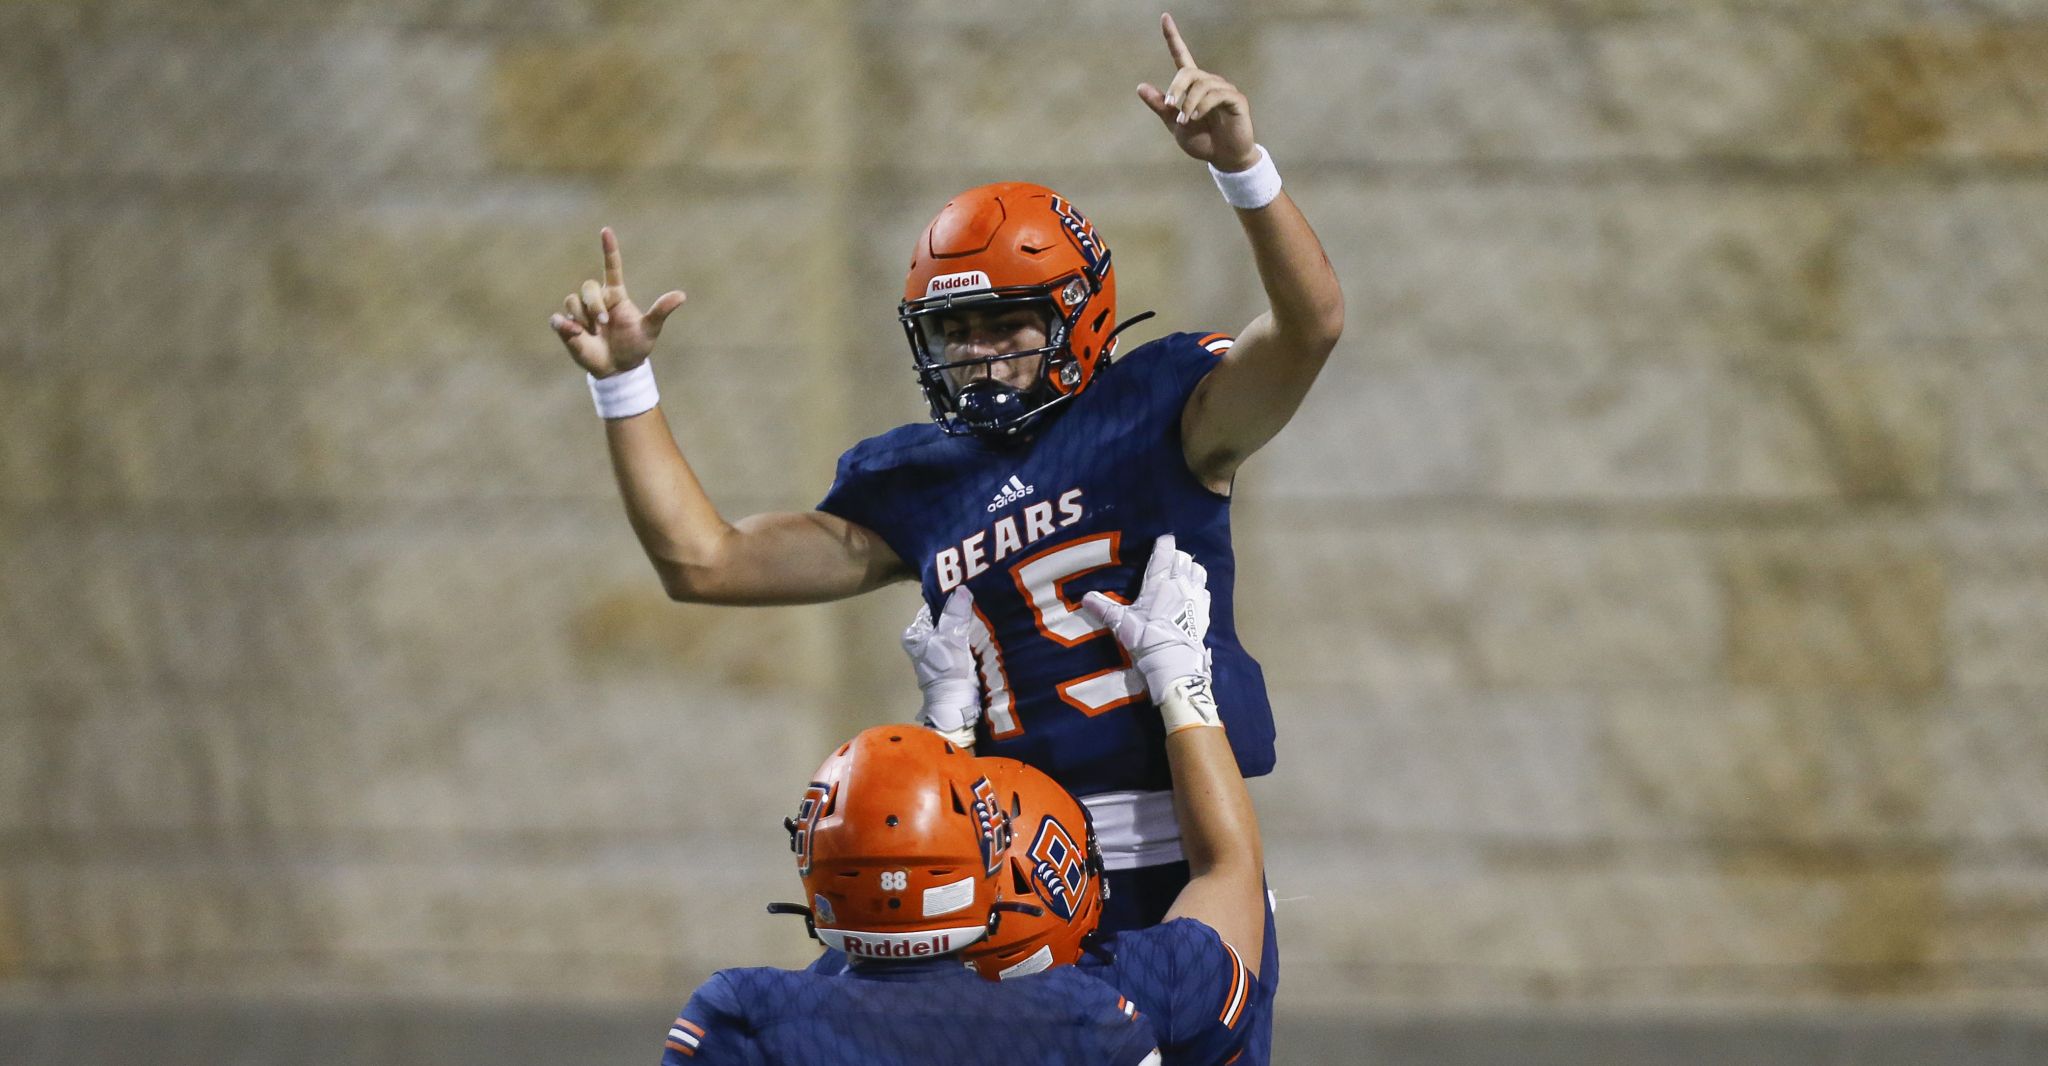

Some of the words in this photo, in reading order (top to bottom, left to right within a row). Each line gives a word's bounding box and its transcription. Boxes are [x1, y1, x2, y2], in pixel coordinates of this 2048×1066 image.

[932, 274, 979, 291] Riddell
[987, 485, 1034, 512] adidas
[936, 488, 1083, 592] BEARS
[971, 531, 1147, 740] 15
[881, 871, 907, 891] 88
[843, 935, 949, 957] Riddell
